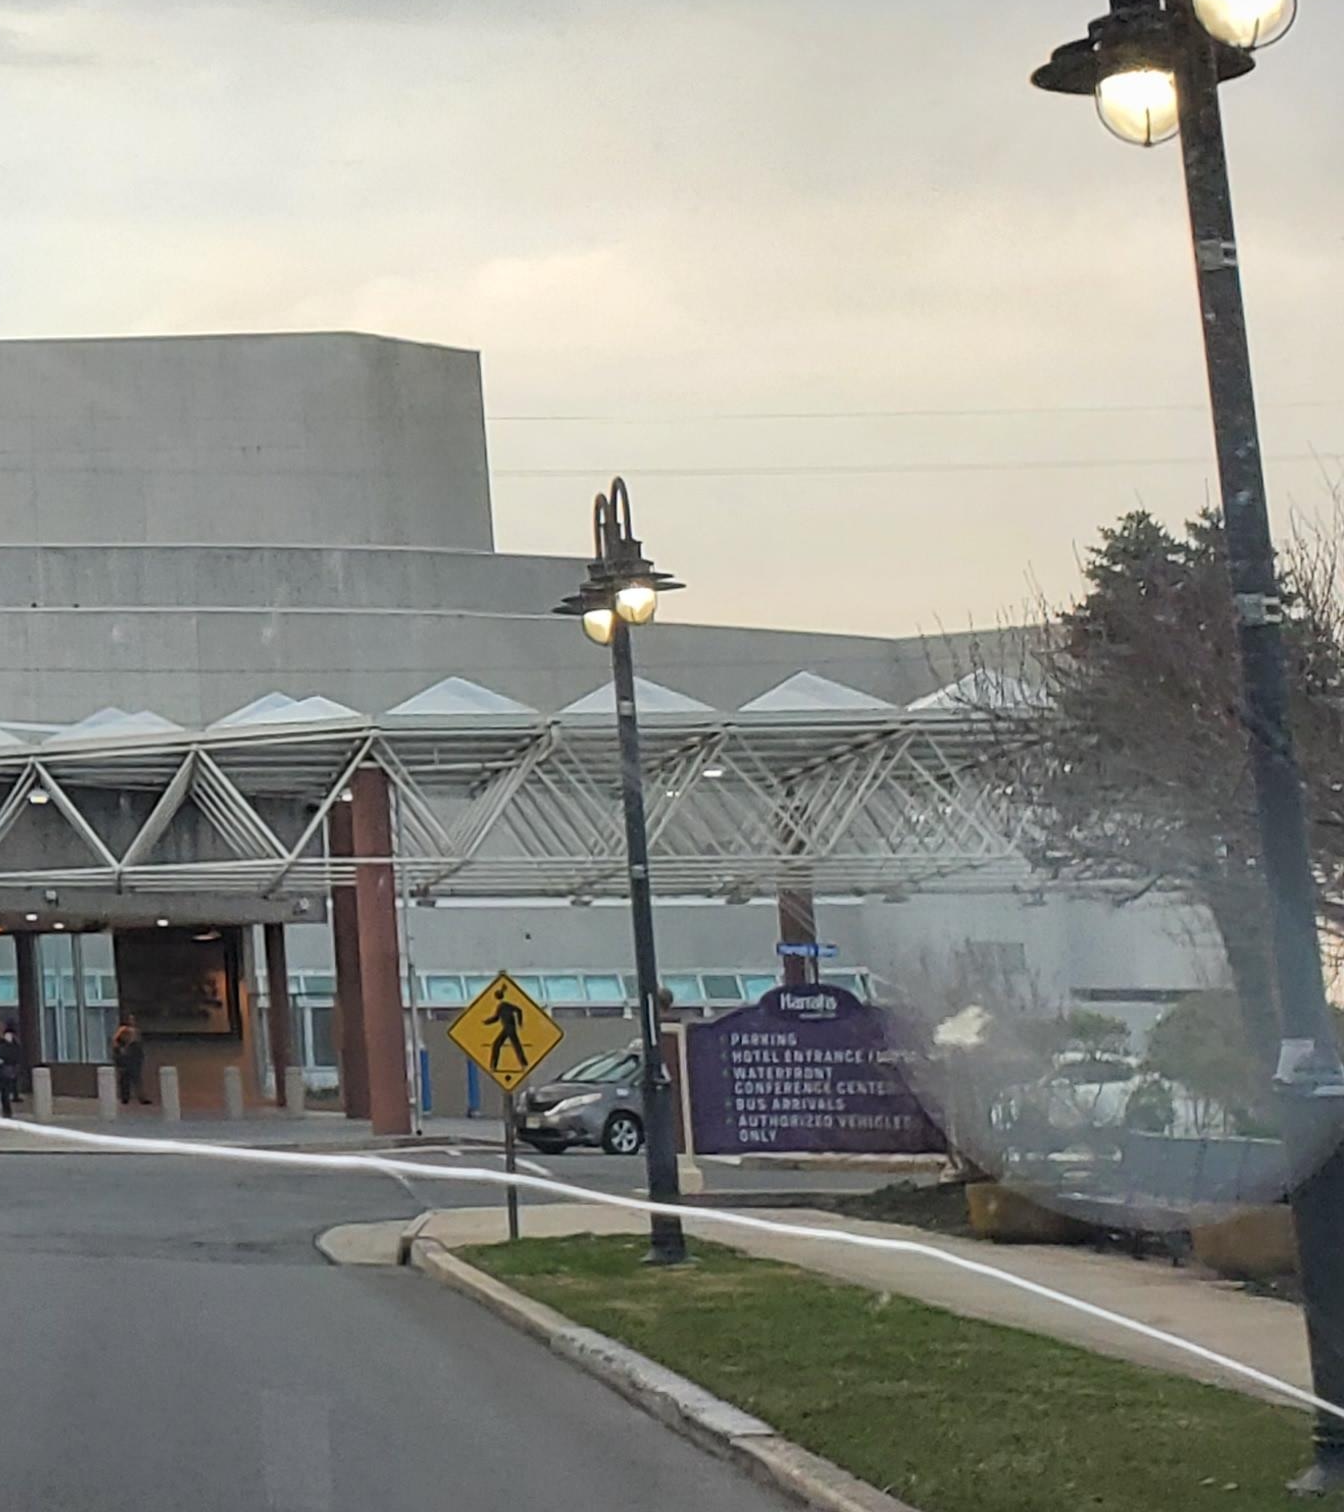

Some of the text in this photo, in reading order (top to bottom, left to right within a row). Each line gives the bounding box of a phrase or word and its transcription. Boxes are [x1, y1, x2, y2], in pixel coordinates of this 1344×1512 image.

[730, 1032, 798, 1047] PARKING
[731, 1049, 780, 1064] HOTEL
[784, 1049, 864, 1064] ENTRANCE
[732, 1066, 833, 1080] WATERFRONT
[734, 1081, 832, 1095] CONFERENCE
[735, 1097, 847, 1111] BUS ARRIVALS
[738, 1113, 833, 1128] AUTHORIZED
[738, 1129, 778, 1143] ONLY
